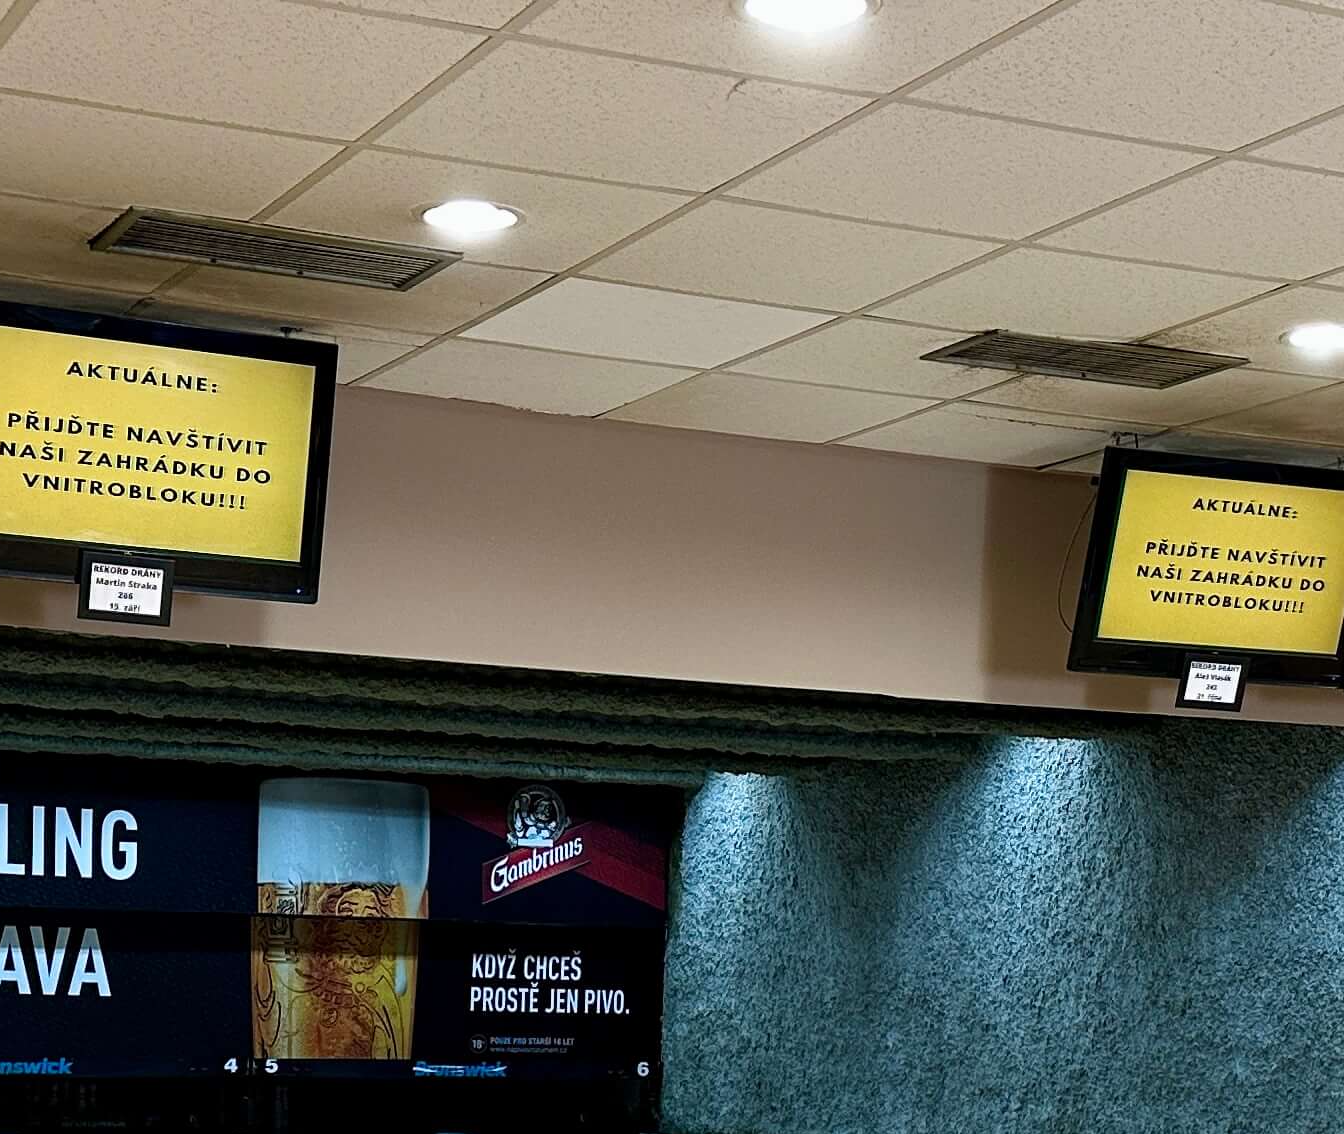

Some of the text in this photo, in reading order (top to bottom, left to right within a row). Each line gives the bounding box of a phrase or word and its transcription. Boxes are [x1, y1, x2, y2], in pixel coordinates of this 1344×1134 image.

[67, 361, 218, 393] AKTUÁLNE:
[8, 411, 268, 456] PŘIJĎTE NAVŠTÍVIT
[0, 440, 271, 484] NAŠI ZAHRÁDKU DO
[23, 473, 246, 509] VNITROBLOKU!!!
[1193, 497, 1298, 519] AKTUÁLNE:
[1145, 538, 1327, 568] PŘIJĎTE NAVŠTÍVIT
[96, 577, 126, 588] Martin
[1136, 563, 1326, 591] NAŠI ZAHRÁDKU DO
[1150, 590, 1304, 614] VNITROBLOKU!!!
[490, 837, 583, 892] Gambrinus
[471, 948, 582, 981] KDYŽ CHCEŠ
[469, 982, 631, 1015] PROSTĚ JEN PIVO.
[223, 1058, 238, 1073] 4
[264, 1059, 278, 1073] 5
[637, 1062, 650, 1077] 6
